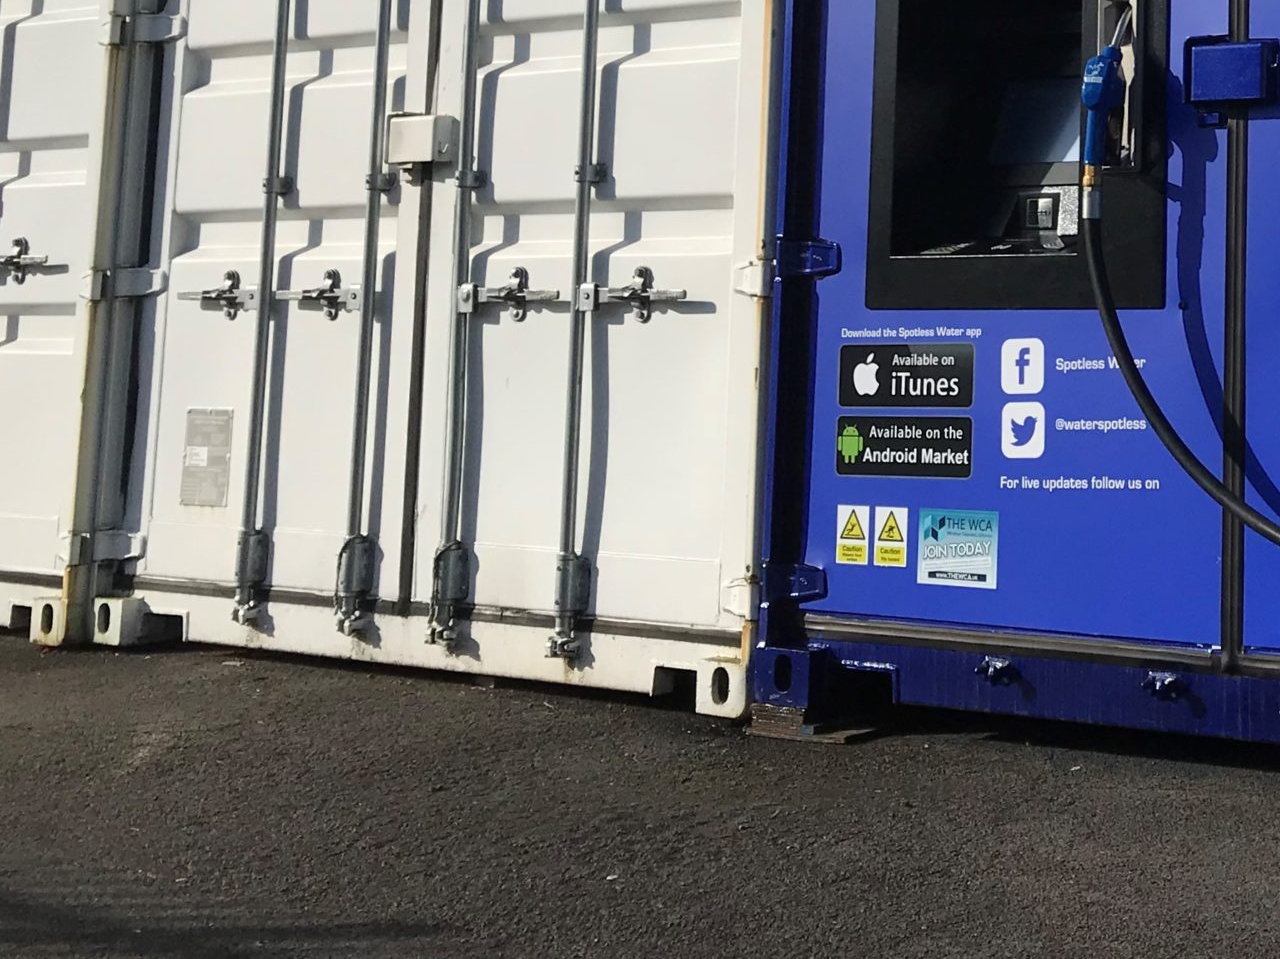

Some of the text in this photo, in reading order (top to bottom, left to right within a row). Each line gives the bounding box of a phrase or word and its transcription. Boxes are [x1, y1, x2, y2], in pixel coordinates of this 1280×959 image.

[841, 326, 982, 339] Download the Spotless Water app
[892, 353, 955, 366] Available on
[1055, 356, 1146, 373] Spotless Wer
[891, 371, 959, 396] iTunes
[869, 425, 963, 439] Available on the
[1055, 417, 1147, 433] @waterspotless
[862, 447, 969, 465] Android Market
[1000, 476, 1160, 492] For live updates follow us on
[947, 517, 993, 531] THE WCA
[842, 545, 863, 553] Caution
[880, 547, 901, 555] Caution
[922, 541, 991, 559] JOIN TODAY
